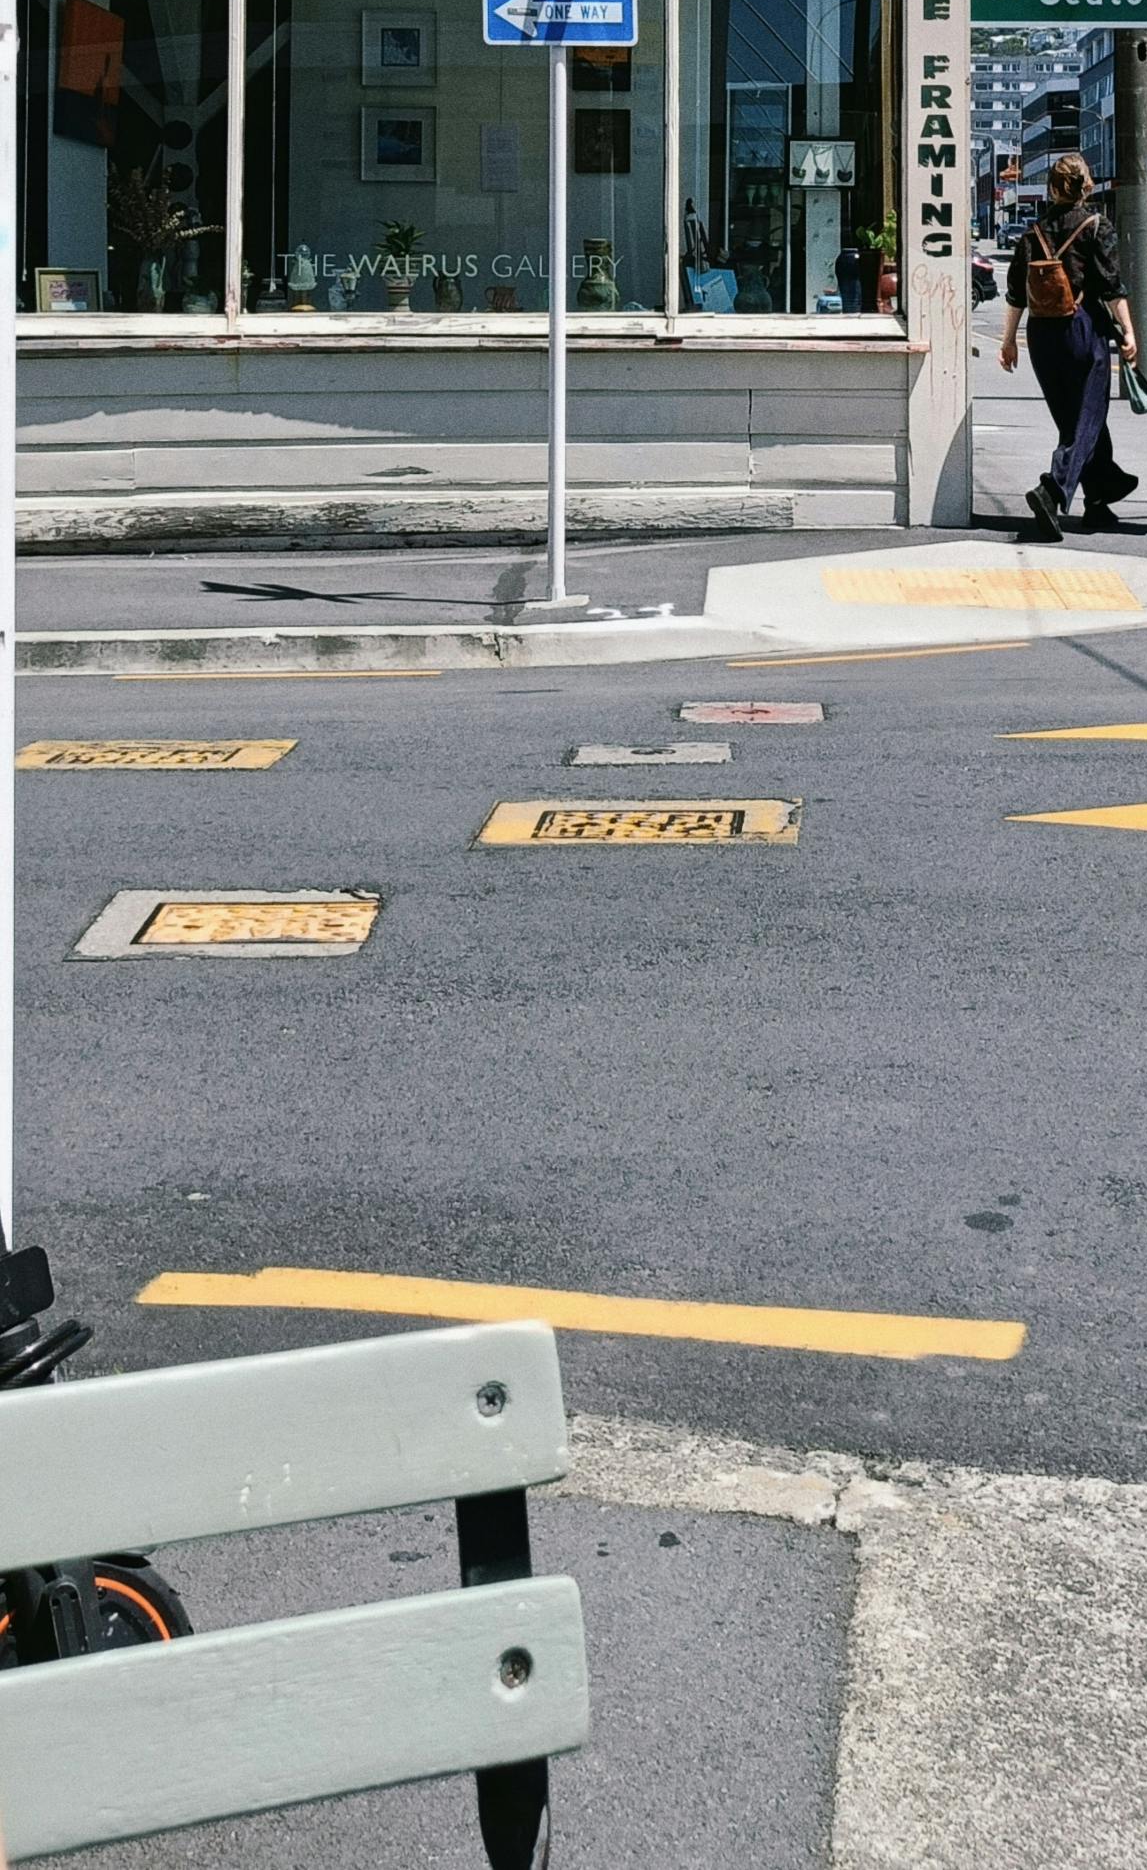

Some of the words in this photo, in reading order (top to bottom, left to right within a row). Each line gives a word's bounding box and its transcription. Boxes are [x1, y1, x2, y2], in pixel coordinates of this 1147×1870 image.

[545, 4, 572, 19] ONE
[580, 5, 609, 19] WAY
[918, 56, 956, 258] FRAMING
[277, 254, 336, 277] THE
[349, 254, 478, 278] WALRUS
[491, 254, 624, 278] GALERY
